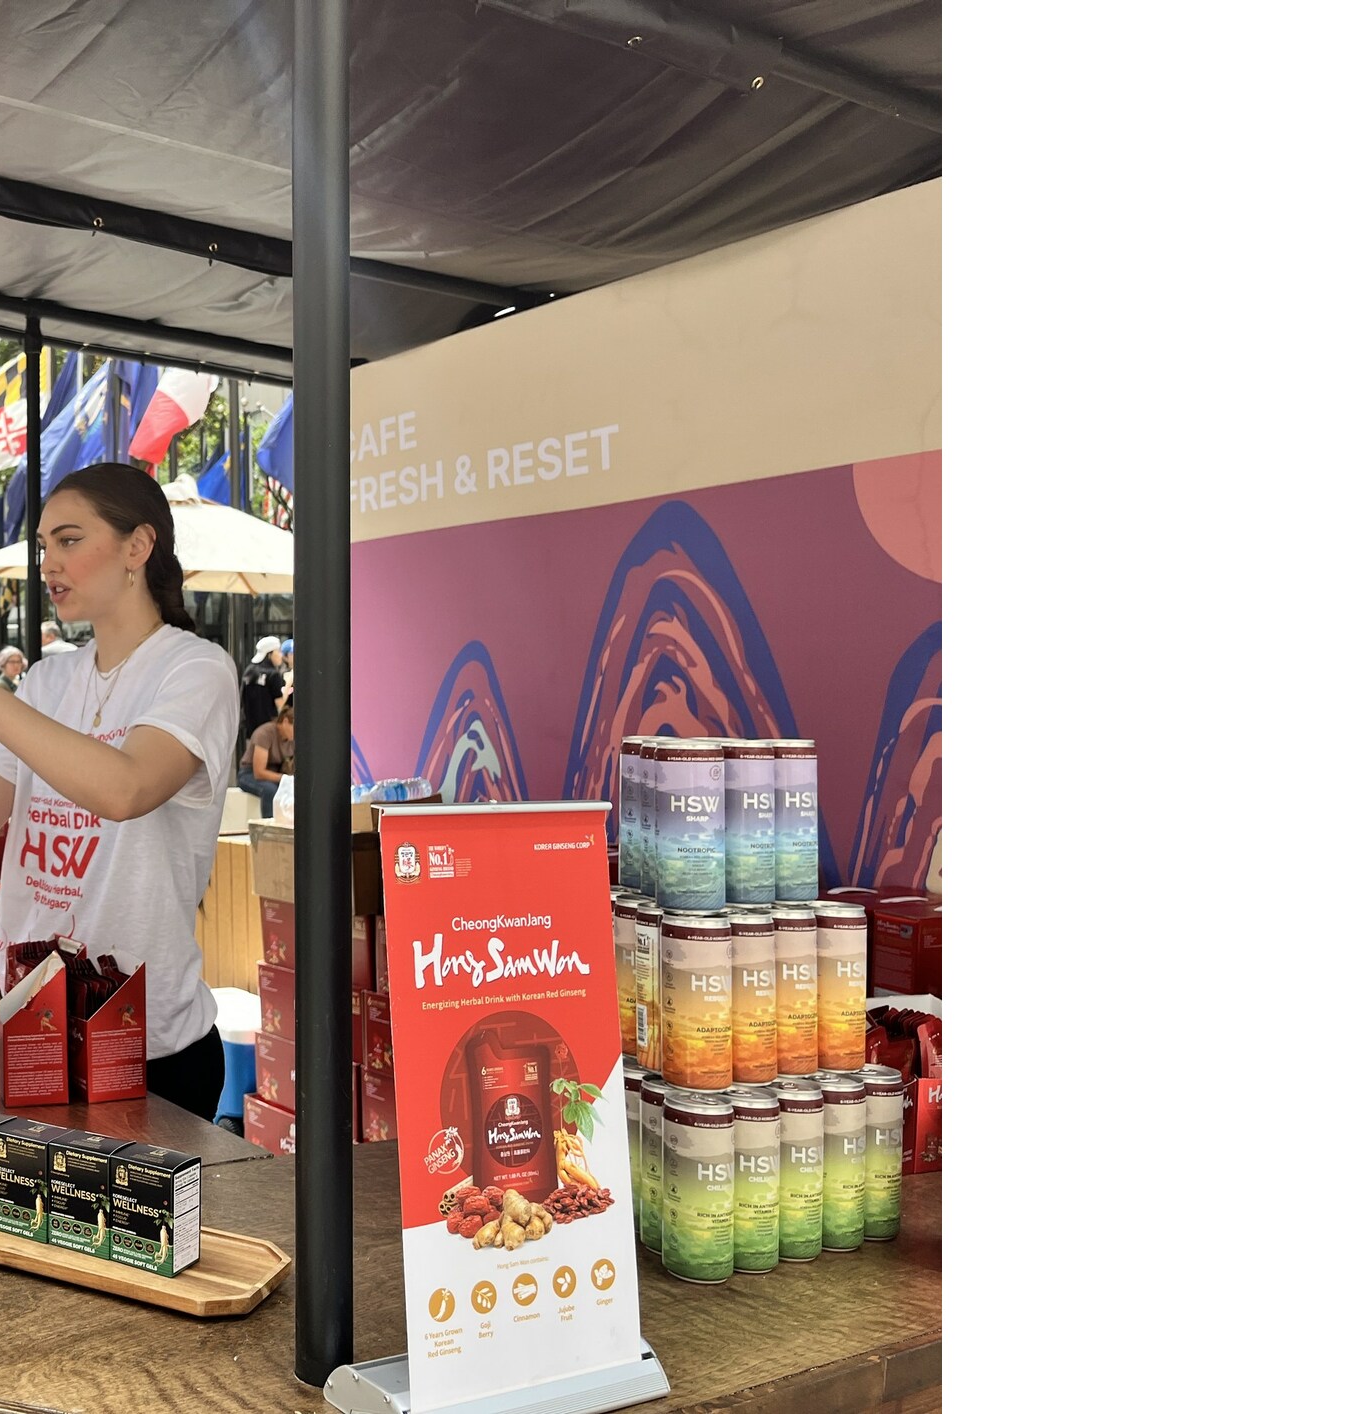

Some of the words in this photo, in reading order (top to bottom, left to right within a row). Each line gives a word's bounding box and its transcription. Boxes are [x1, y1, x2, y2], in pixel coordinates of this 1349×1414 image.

[454, 454, 477, 495] &
[487, 423, 620, 489] RESET
[670, 795, 720, 813] HSW
[552, 842, 576, 850] GINSENG
[576, 841, 591, 849] CORP
[20, 827, 101, 880] HSW
[428, 852, 448, 866] No.1
[451, 913, 552, 933] CheongKwanJang
[422, 1000, 460, 1011] Energizing
[460, 995, 484, 1006] Herbal
[485, 994, 505, 1004] Drink
[505, 993, 521, 1002] with
[522, 991, 546, 1001] Korean
[546, 990, 559, 999] Red
[559, 988, 587, 998] Ginseng
[6, 1136, 21, 1145] Dietary
[20, 1139, 46, 1150] Supplement
[65, 1150, 81, 1160] Dietary
[81, 1153, 108, 1164] Supplement
[423, 1143, 448, 1166] PANAX
[427, 1148, 456, 1175] GINSENG
[127, 1163, 144, 1173] Dietary
[144, 1167, 171, 1179] Supplement
[50, 1183, 96, 1202] WELLNESS
[112, 1198, 160, 1218] WELLNESS
[12, 1226, 23, 1234] SOFT
[57, 1239, 72, 1248] VEGGIE
[72, 1242, 84, 1251] SOFT
[117, 1254, 134, 1265] VEGGIE
[134, 1258, 146, 1267] SOFT
[596, 1297, 614, 1306] Ginger
[557, 1304, 575, 1314] Jujube
[513, 1312, 541, 1323] Cinnamon
[560, 1313, 573, 1323] Fruit
[480, 1320, 491, 1330] Goji
[429, 1331, 444, 1340] Years
[444, 1328, 463, 1337] Grown
[478, 1330, 494, 1340] Berry
[434, 1339, 455, 1348] Korean
[427, 1350, 439, 1359] Red
[439, 1346, 462, 1356] Ginseng
